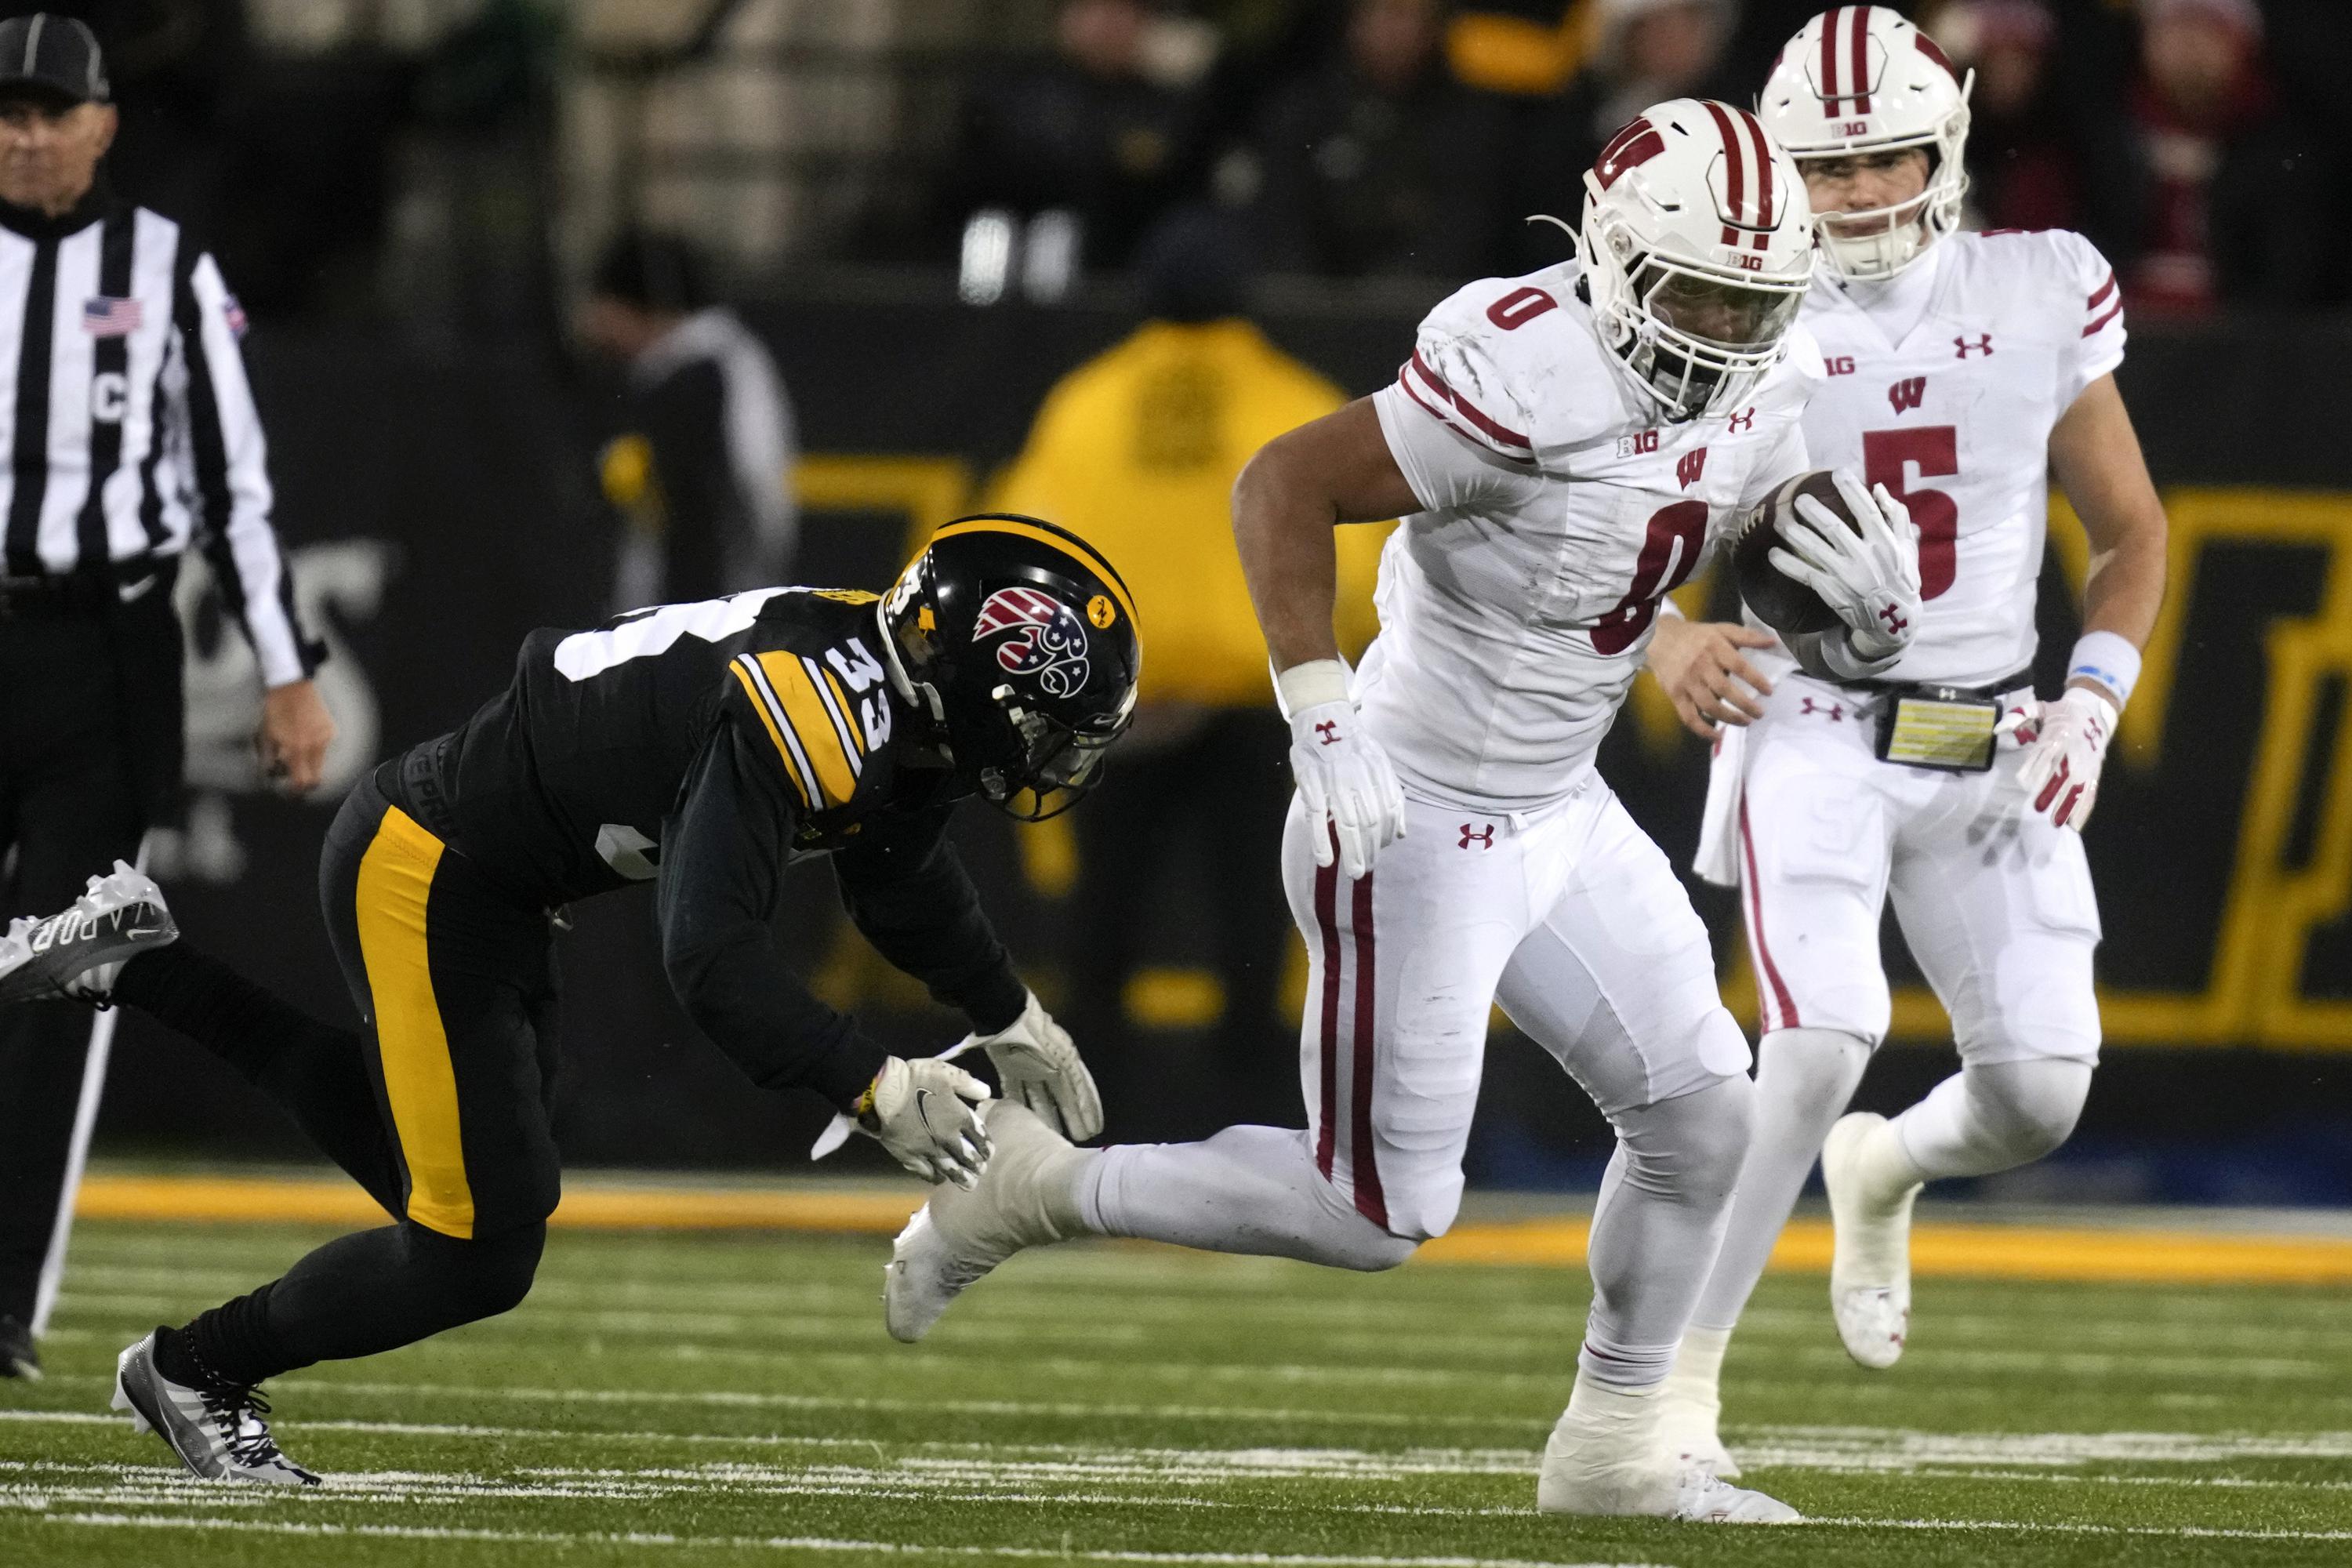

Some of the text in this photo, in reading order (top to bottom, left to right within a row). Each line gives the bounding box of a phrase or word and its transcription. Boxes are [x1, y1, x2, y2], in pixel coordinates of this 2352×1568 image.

[1486, 285, 1559, 331] 0
[1824, 356, 1856, 377] 1G
[94, 371, 129, 422] C
[1888, 376, 1926, 416] W
[1675, 446, 1708, 492] W
[1863, 425, 1958, 602] 5
[825, 637, 891, 753] 33
